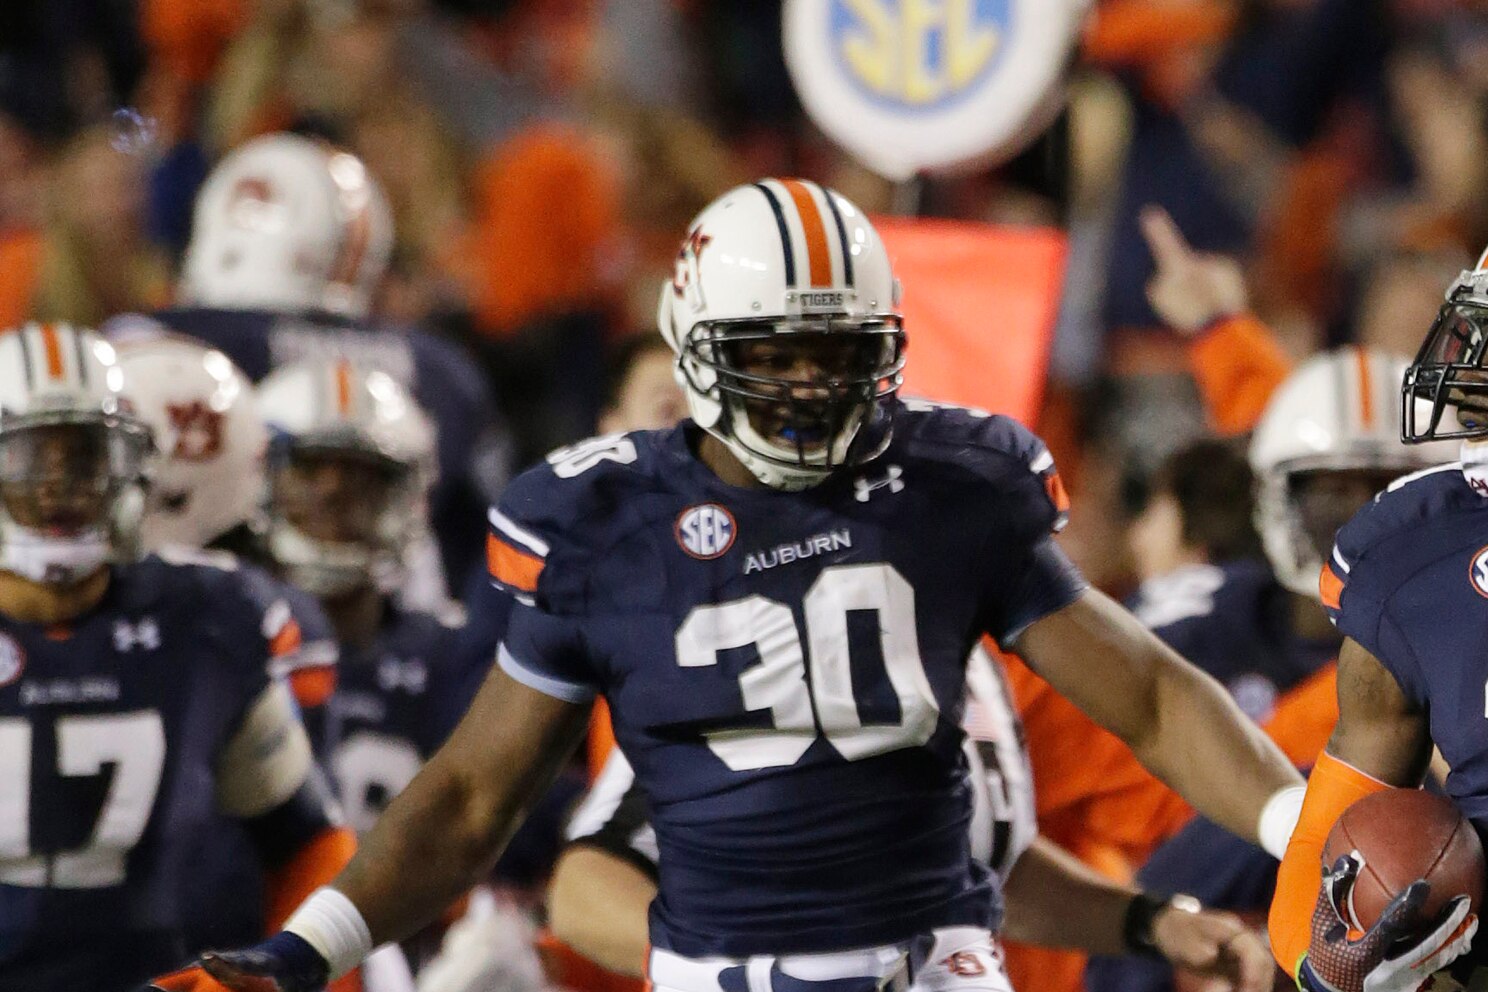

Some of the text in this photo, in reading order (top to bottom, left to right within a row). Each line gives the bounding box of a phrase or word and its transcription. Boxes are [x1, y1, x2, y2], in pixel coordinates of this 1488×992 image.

[800, 292, 844, 308] TIGERS
[680, 503, 732, 556] SEC
[742, 529, 852, 575] AUBURN
[674, 562, 940, 771] 30
